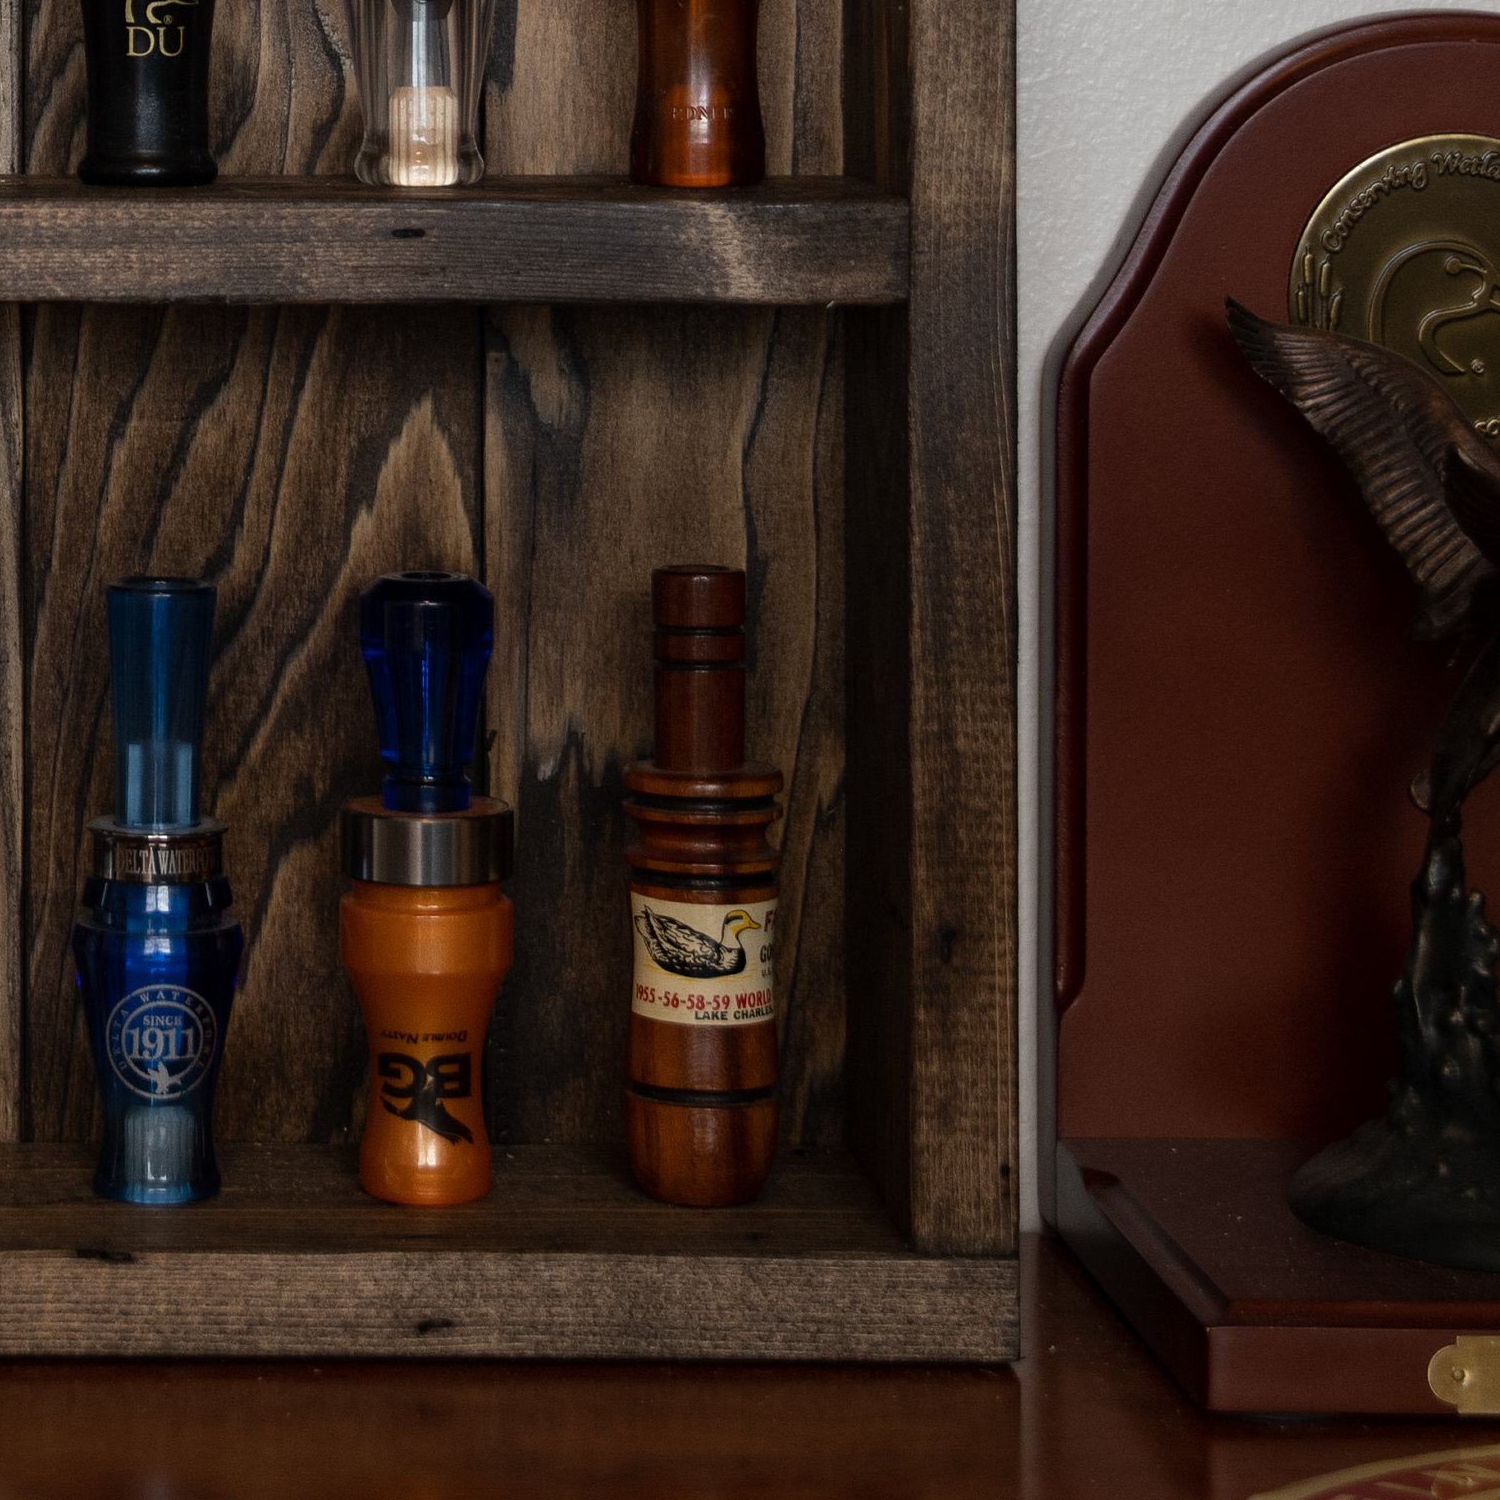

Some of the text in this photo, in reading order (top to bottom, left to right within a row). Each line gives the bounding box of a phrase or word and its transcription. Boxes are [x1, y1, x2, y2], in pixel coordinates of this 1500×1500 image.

[126, 26, 185, 57] DU
[1320, 160, 1428, 252] Conserving
[115, 847, 214, 875] DELTA WATERFO
[735, 987, 772, 1010] WORLD
[143, 1015, 182, 1026] SINCE
[694, 1010, 729, 1021] LAKE
[126, 1027, 196, 1060] 1911
